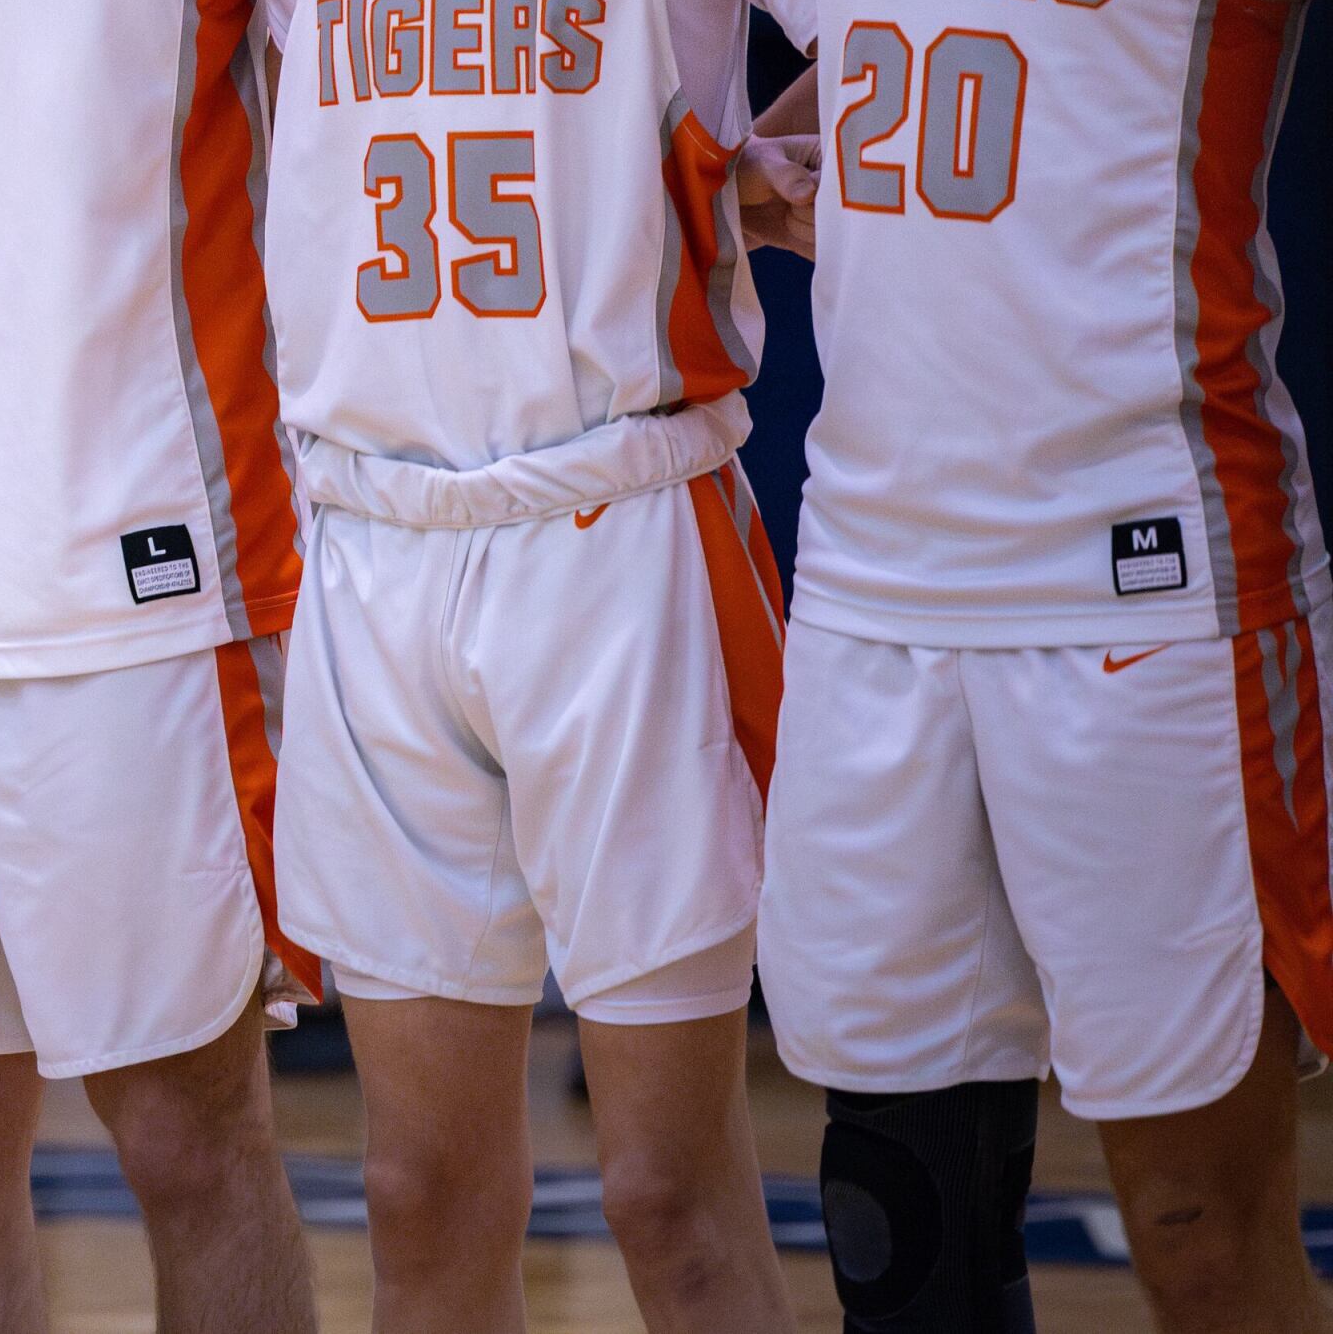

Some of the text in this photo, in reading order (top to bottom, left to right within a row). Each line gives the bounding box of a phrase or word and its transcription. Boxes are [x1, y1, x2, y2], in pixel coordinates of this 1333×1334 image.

[835, 20, 1028, 223] 20
[356, 130, 546, 323] 35
[147, 537, 166, 557] L
[1132, 526, 1158, 551] M
